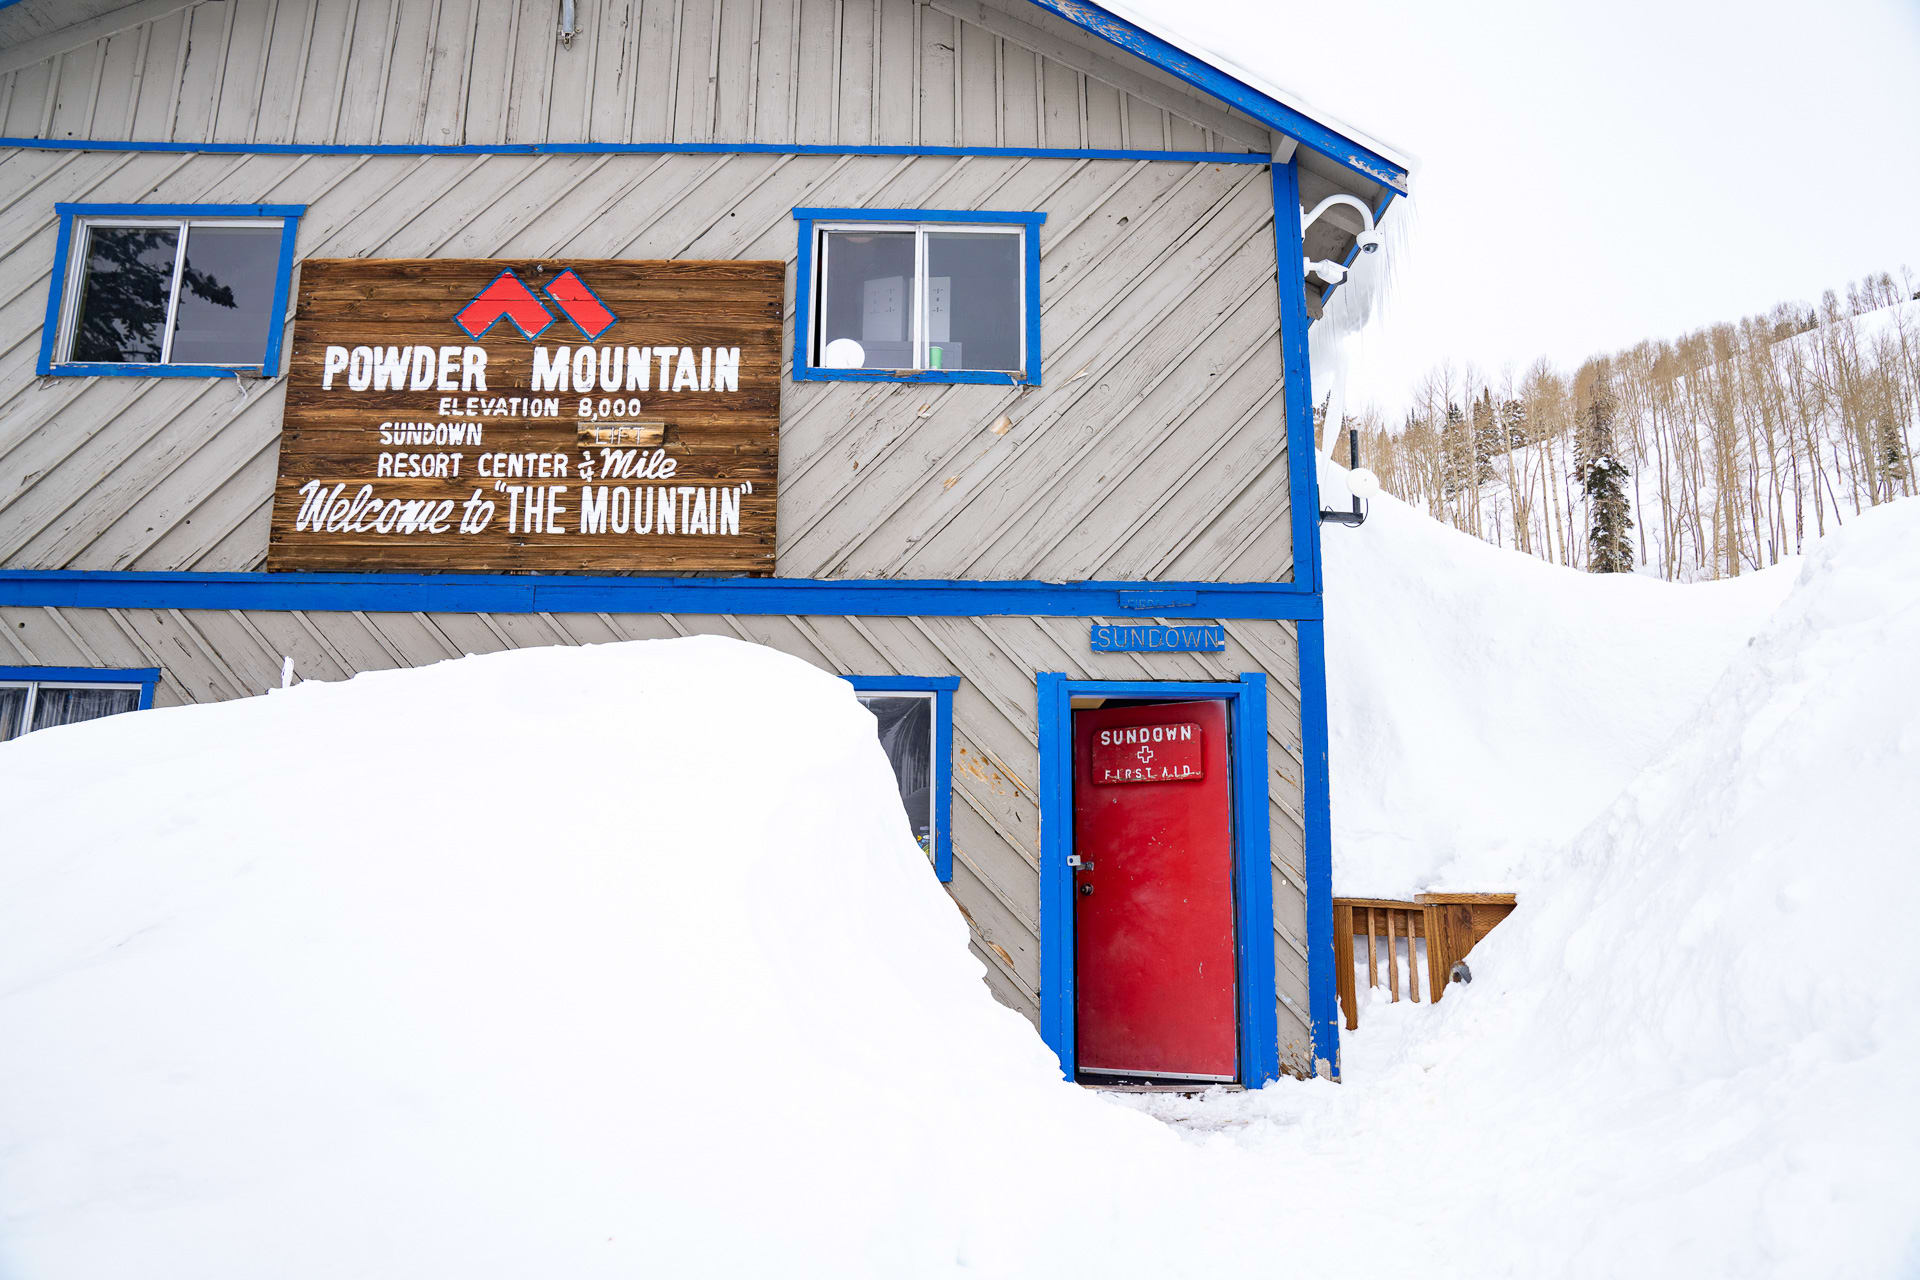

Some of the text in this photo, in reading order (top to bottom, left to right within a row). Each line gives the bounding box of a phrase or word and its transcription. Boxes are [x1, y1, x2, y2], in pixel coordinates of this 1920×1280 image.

[323, 346, 740, 392] POWDER MOUNTAIN
[439, 397, 641, 422] ELEVATION 8,000
[380, 422, 482, 446] SUNDOWN
[596, 427, 645, 445] LIFT
[377, 452, 463, 478] RESORT
[478, 452, 568, 478] CENTER
[600, 448, 677, 479] Mile
[296, 479, 452, 534] Welcome
[459, 488, 496, 535] to
[1098, 628, 1219, 649] SUNDOWN
[1101, 726, 1191, 746] SUNDOWN
[1105, 765, 1191, 780] FIRST AID
